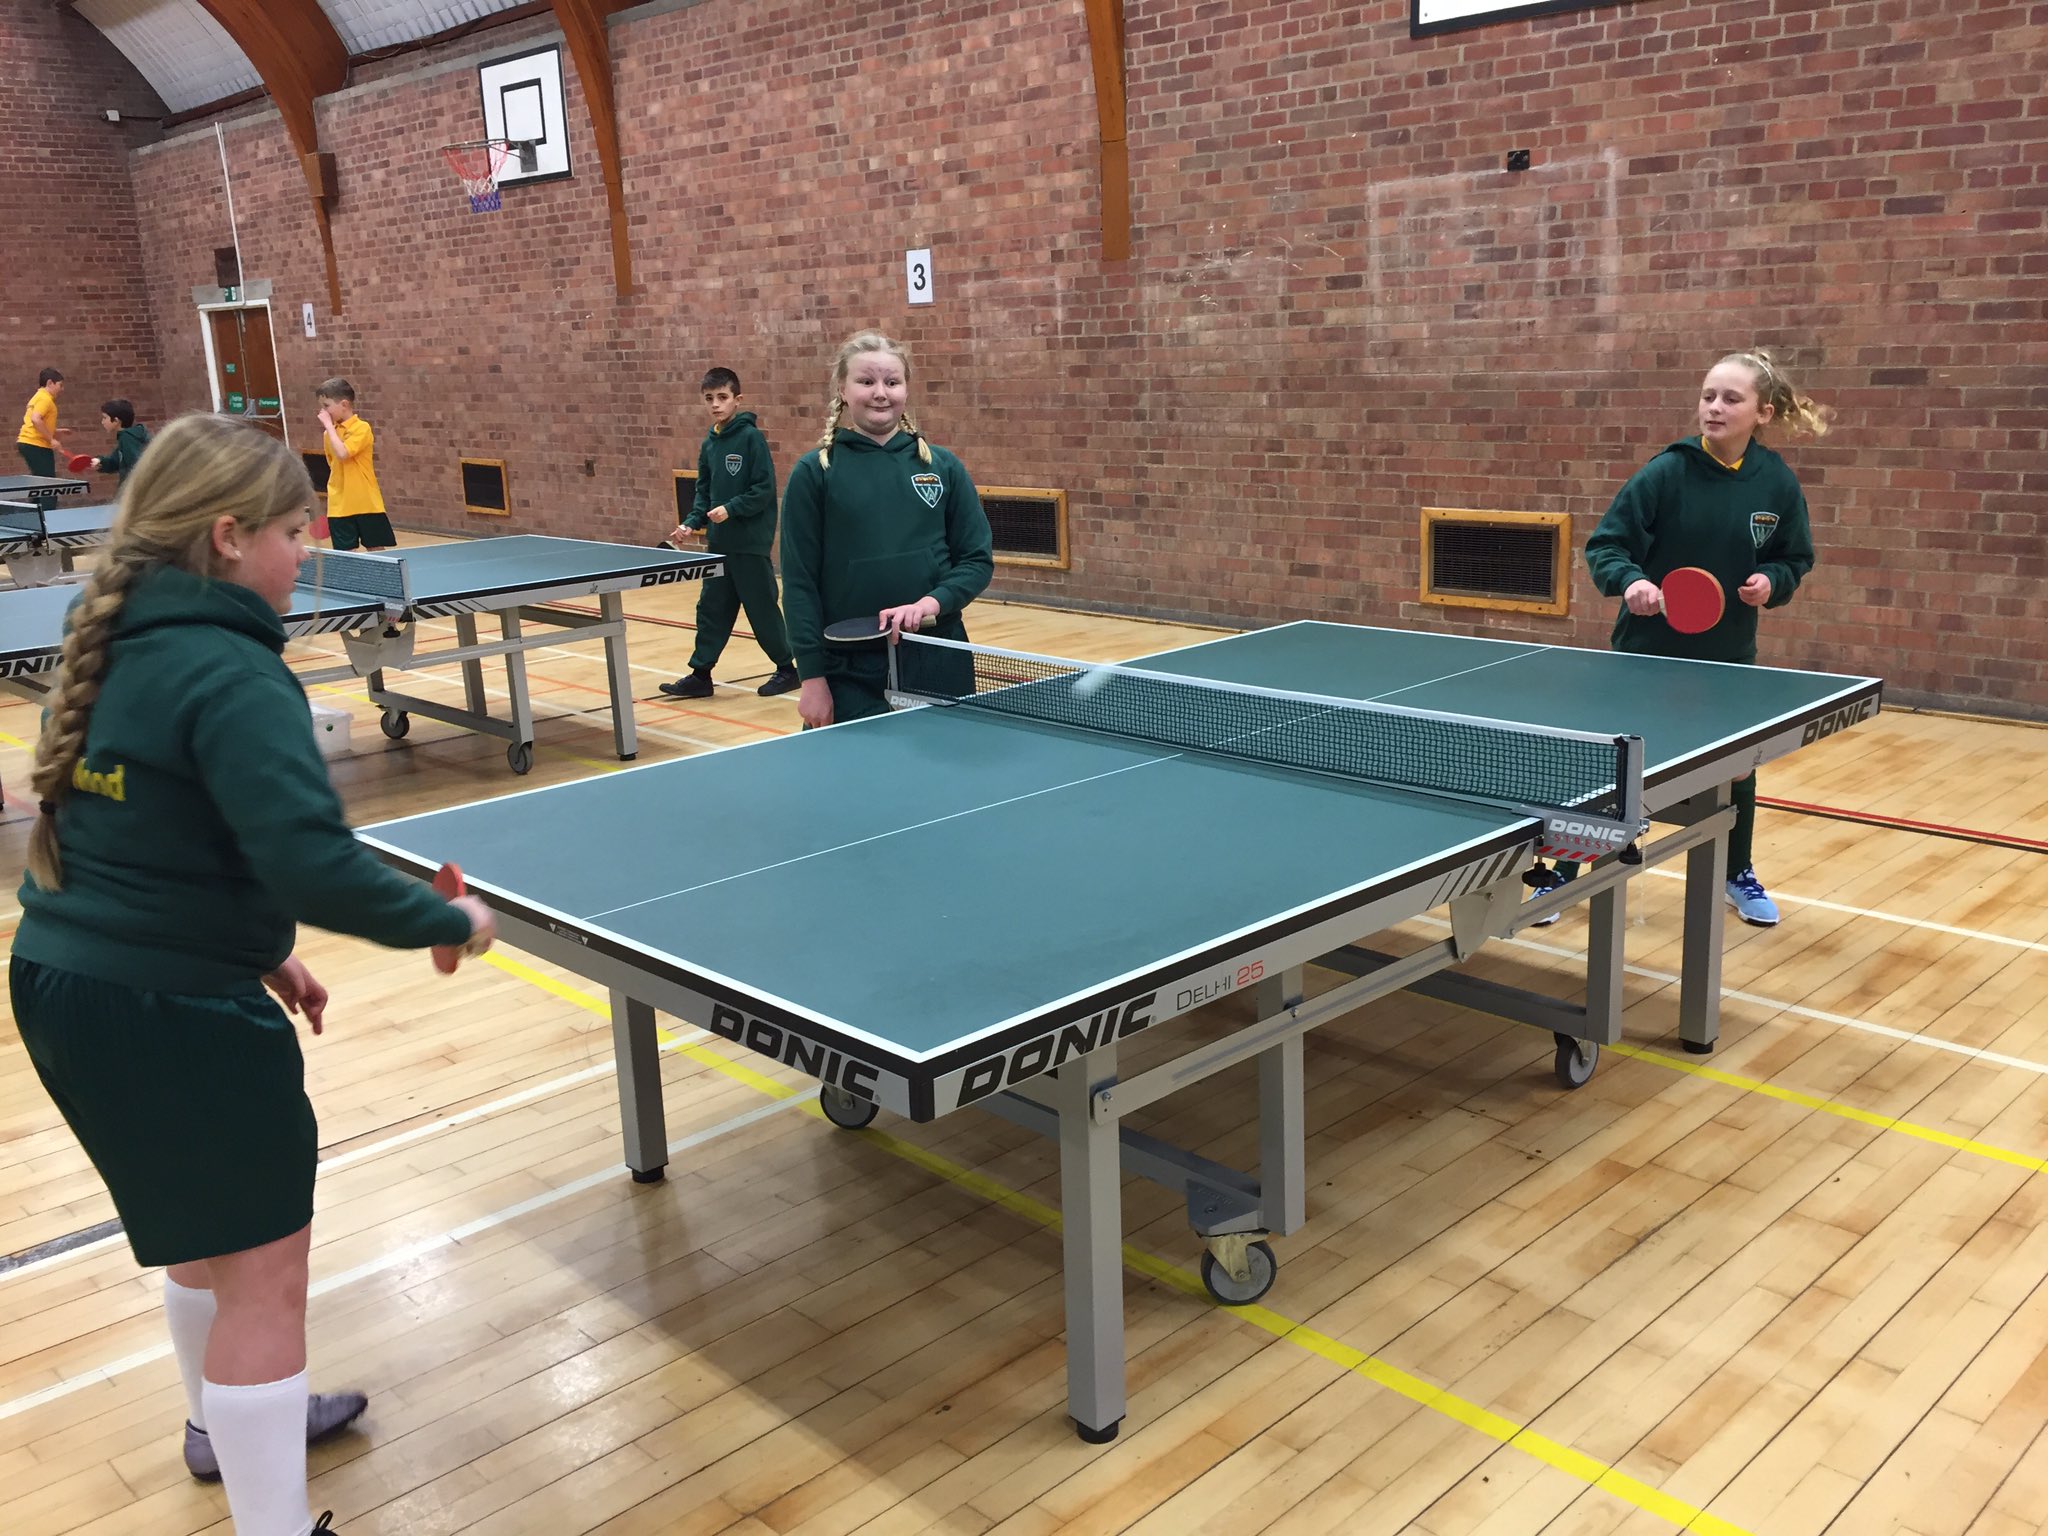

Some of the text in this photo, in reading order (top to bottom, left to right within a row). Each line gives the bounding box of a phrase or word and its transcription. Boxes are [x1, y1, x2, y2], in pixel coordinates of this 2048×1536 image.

[914, 263, 926, 291] 3
[306, 312, 313, 329] 4
[28, 486, 82, 498] DONIC
[640, 564, 717, 587] DONIC
[1801, 698, 1873, 748] DONIC
[1549, 819, 1626, 842] DONIC
[1176, 960, 1264, 1011] DELHI 25
[710, 1003, 879, 1101] DONIC
[956, 991, 1157, 1108] DONIC
